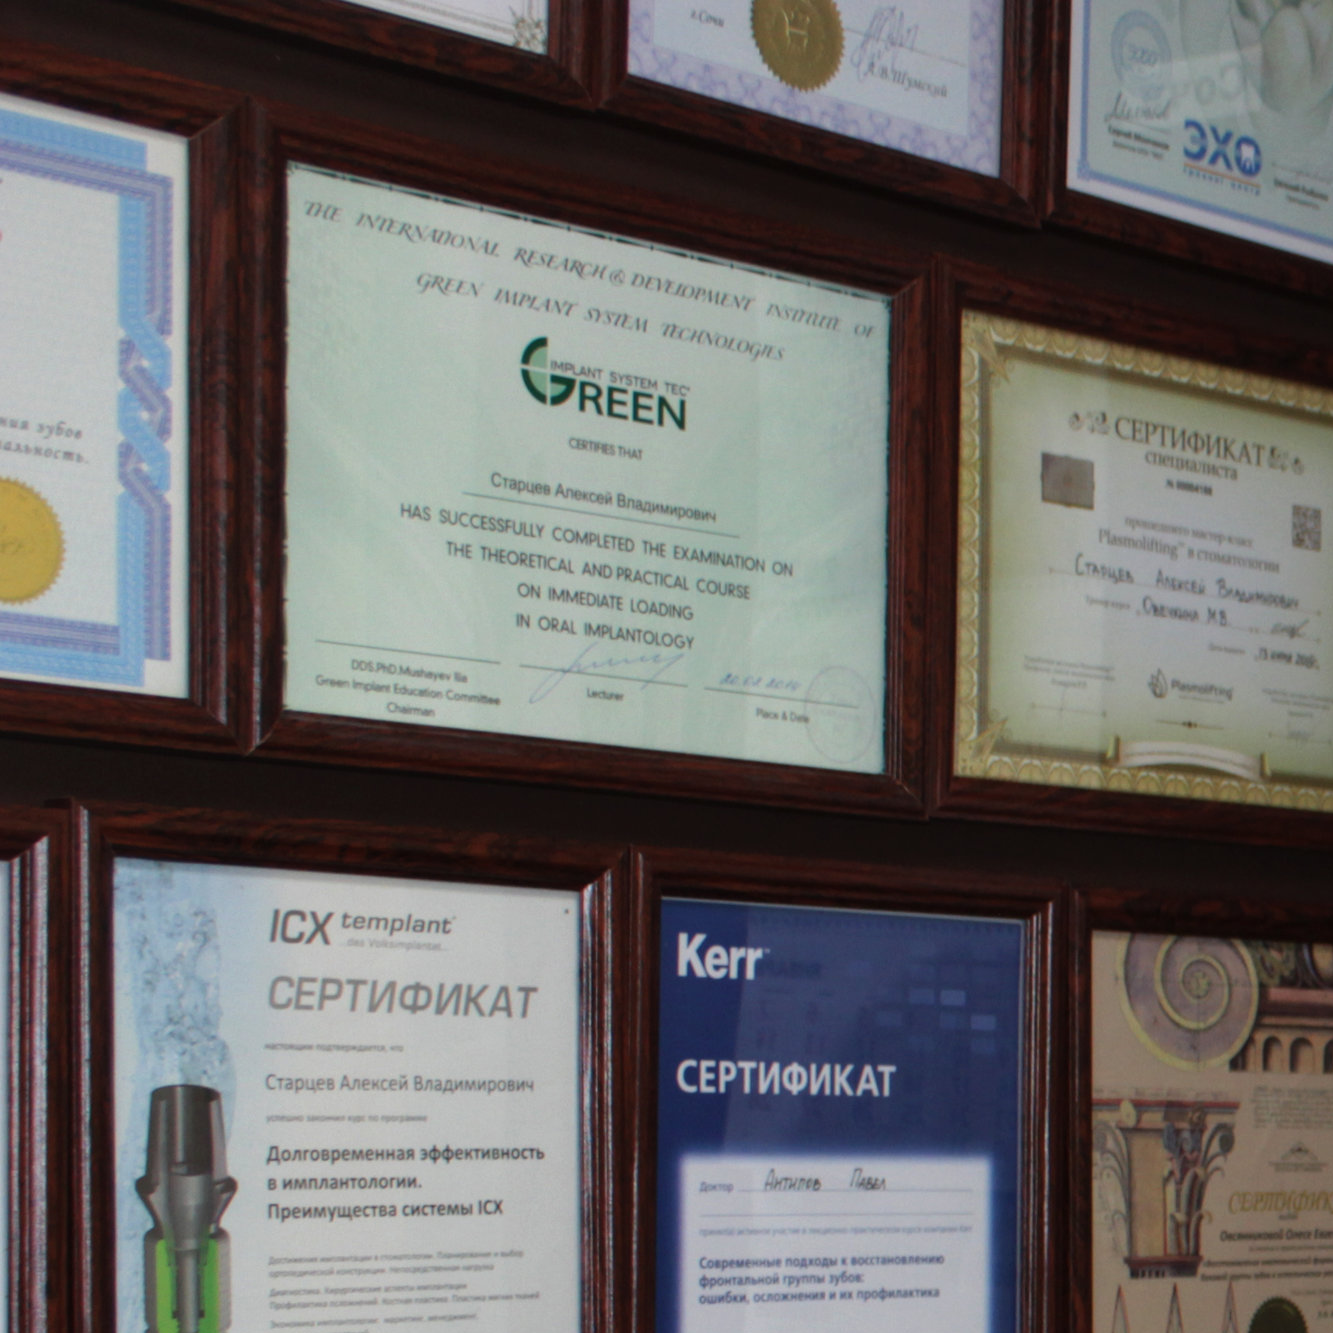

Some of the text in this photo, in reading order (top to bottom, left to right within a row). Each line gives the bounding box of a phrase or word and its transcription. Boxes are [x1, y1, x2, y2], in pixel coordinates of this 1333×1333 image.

[1183, 118, 1262, 178] ЭХО
[304, 200, 876, 339] THE INTERNATIONAL RESEARCH & DEVELOPMENT INSTITUTE OF
[416, 272, 786, 362] GREEN IMPLANT SYSTEM TECHNOLOGIES
[521, 336, 687, 431] GREEN
[550, 360, 658, 391] IMPLANT SYSTEM
[568, 437, 643, 460] CERTIFIES THAT
[1115, 417, 1265, 467] СЕРТИФИКАТ
[1145, 452, 1239, 481] специалиста
[490, 472, 717, 523] Старцев Алексей Владимирович
[400, 503, 794, 577] HAS SUCCESSFULLY COMPLETED THE EXAMINATION ON
[446, 541, 751, 601] THE THEORETICAL AND PRACTICAL COURSE
[1197, 549, 1280, 573] стоматологии
[516, 582, 694, 621] ON IMMEDIATE LOADING
[516, 612, 695, 651] IN ORAL IMPLANTOLOGY
[315, 674, 501, 706] Green Implant Education Committee
[586, 687, 625, 702] Lecturer
[386, 702, 436, 718] Chairman
[268, 908, 335, 945] ICX
[341, 912, 453, 936] templant
[676, 932, 763, 980] Kerr
[268, 974, 539, 1019] СЕРТИФИКАТ
[265, 1073, 535, 1094] Старцев Алексей Владимирович
[676, 1058, 897, 1097] СЕРТИФИКАТ
[266, 1145, 545, 1166] Долговременная эффективность
[267, 1173, 423, 1193] в имплантологии.
[700, 1181, 734, 1194] Доктор
[267, 1199, 504, 1222] Преимущества системы ICX
[699, 1254, 944, 1272] Современные подходы к восстановлению
[699, 1273, 864, 1288] фронтальной группы зубов:
[699, 1288, 940, 1305] ошибки, осложнения и их профилактика
